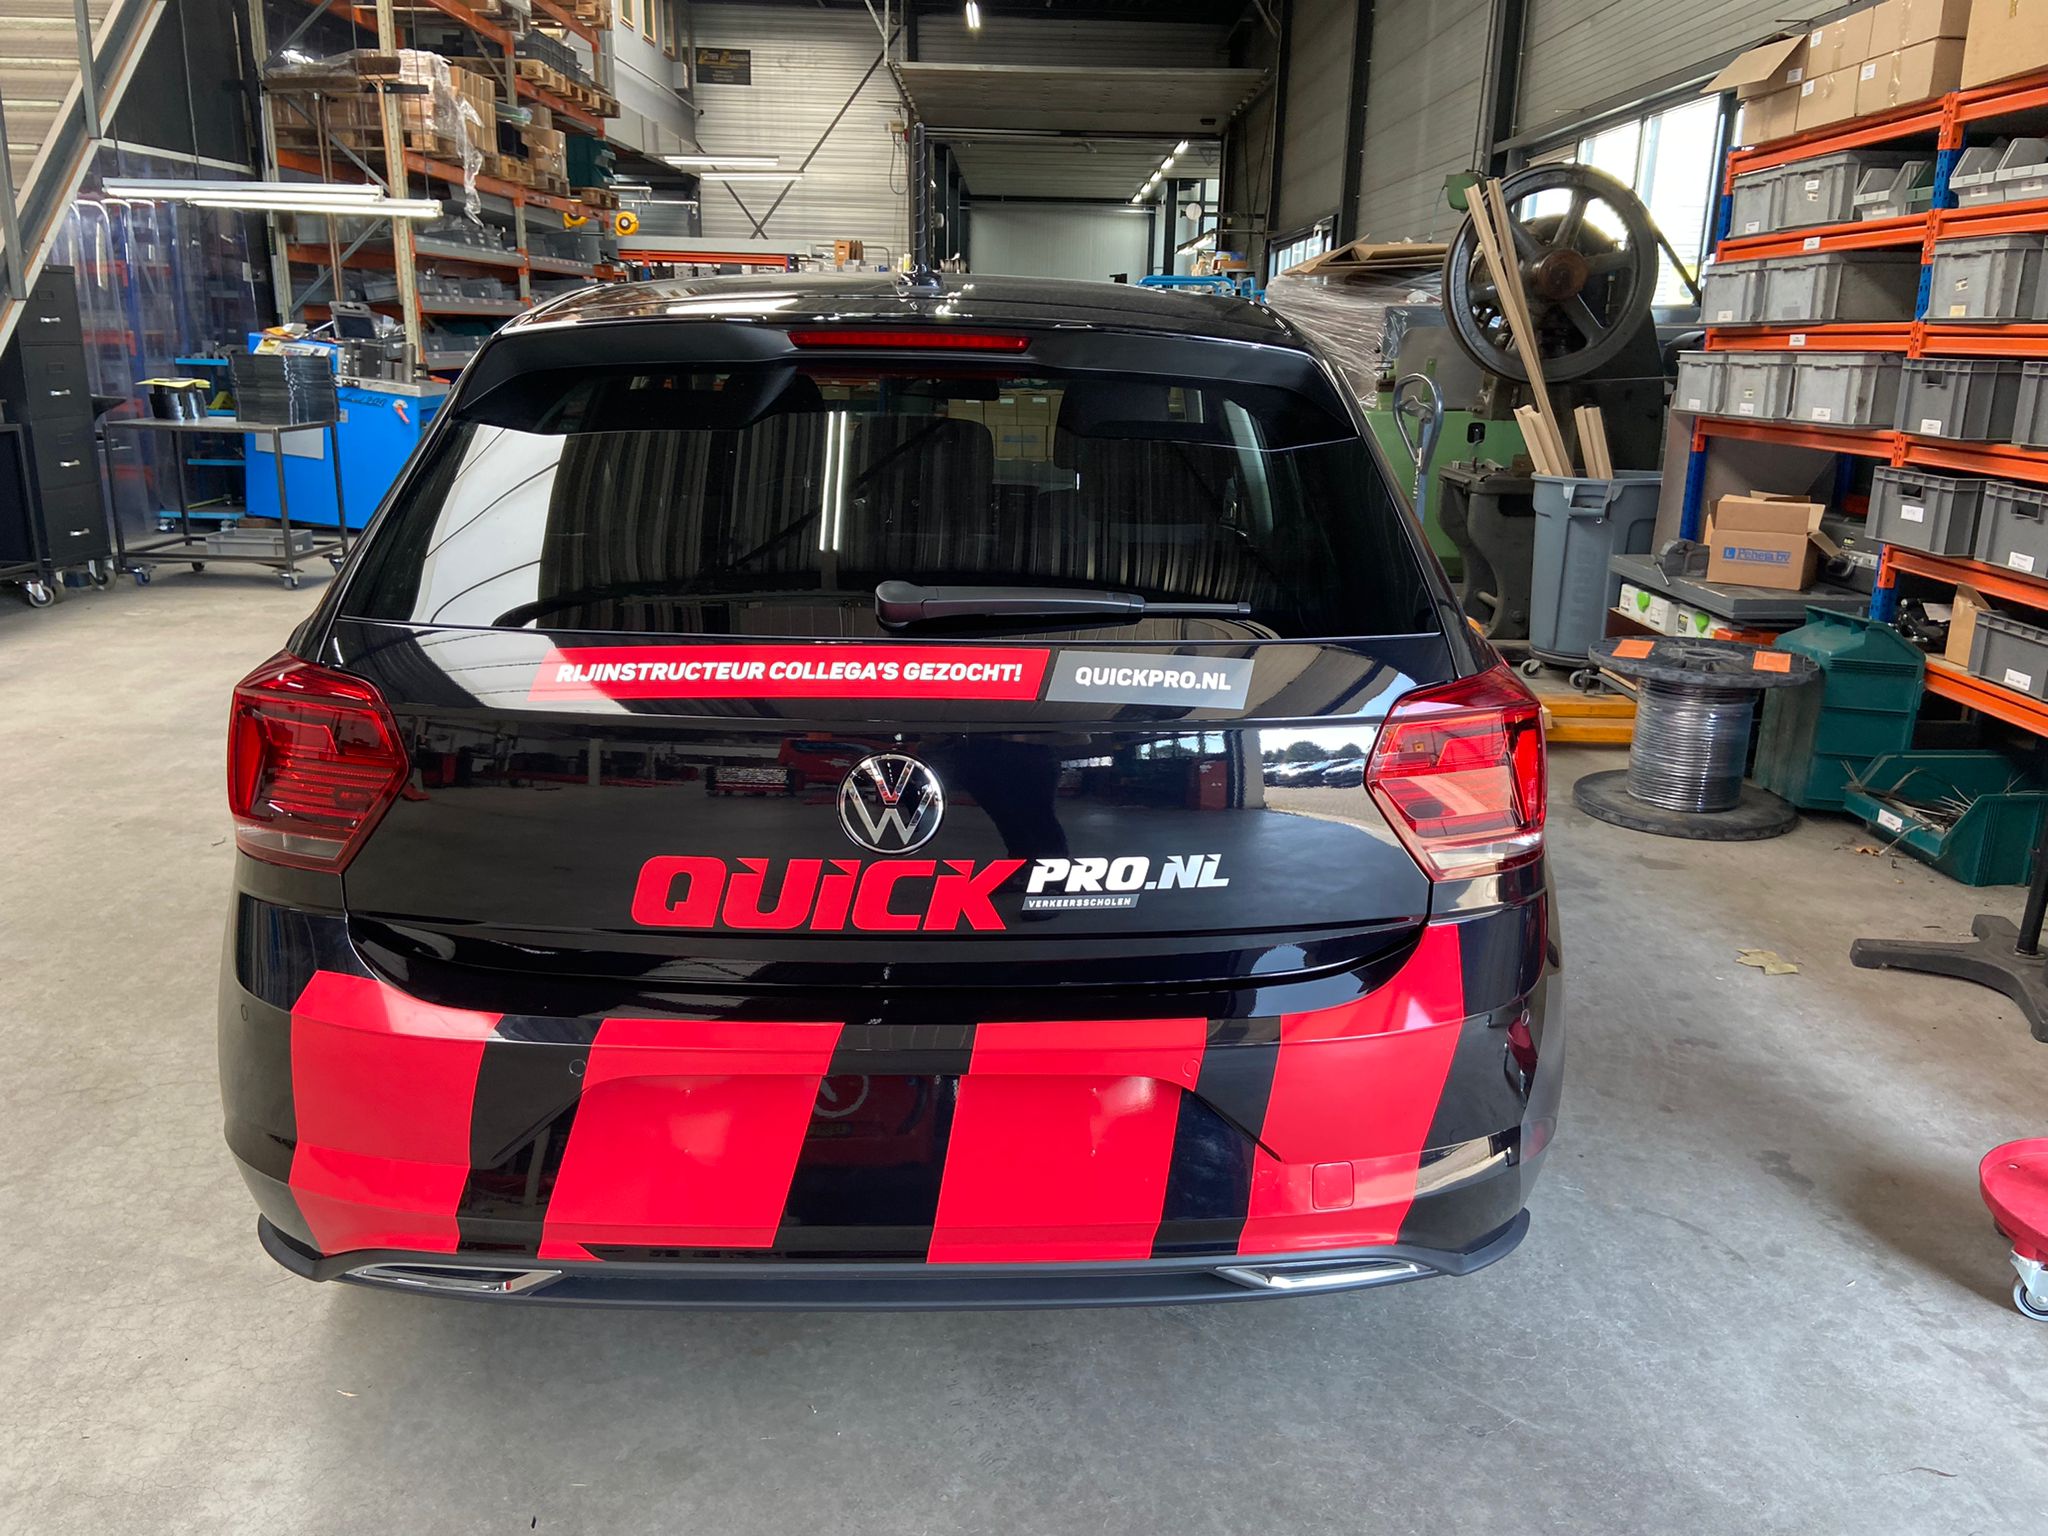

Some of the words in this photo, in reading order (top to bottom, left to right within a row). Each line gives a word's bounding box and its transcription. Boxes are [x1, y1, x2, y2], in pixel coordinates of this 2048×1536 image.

[556, 661, 766, 682] RIJINSTRUCTEUR
[769, 661, 900, 680] COLLEGA'S
[903, 663, 1023, 682] GEZOCHT!
[1075, 666, 1232, 691] QUICKPRO.NL
[631, 855, 1027, 931] QUICK
[1026, 854, 1230, 893] PRO.NL
[1028, 897, 1132, 908] VERKEERSSCHOLEN
